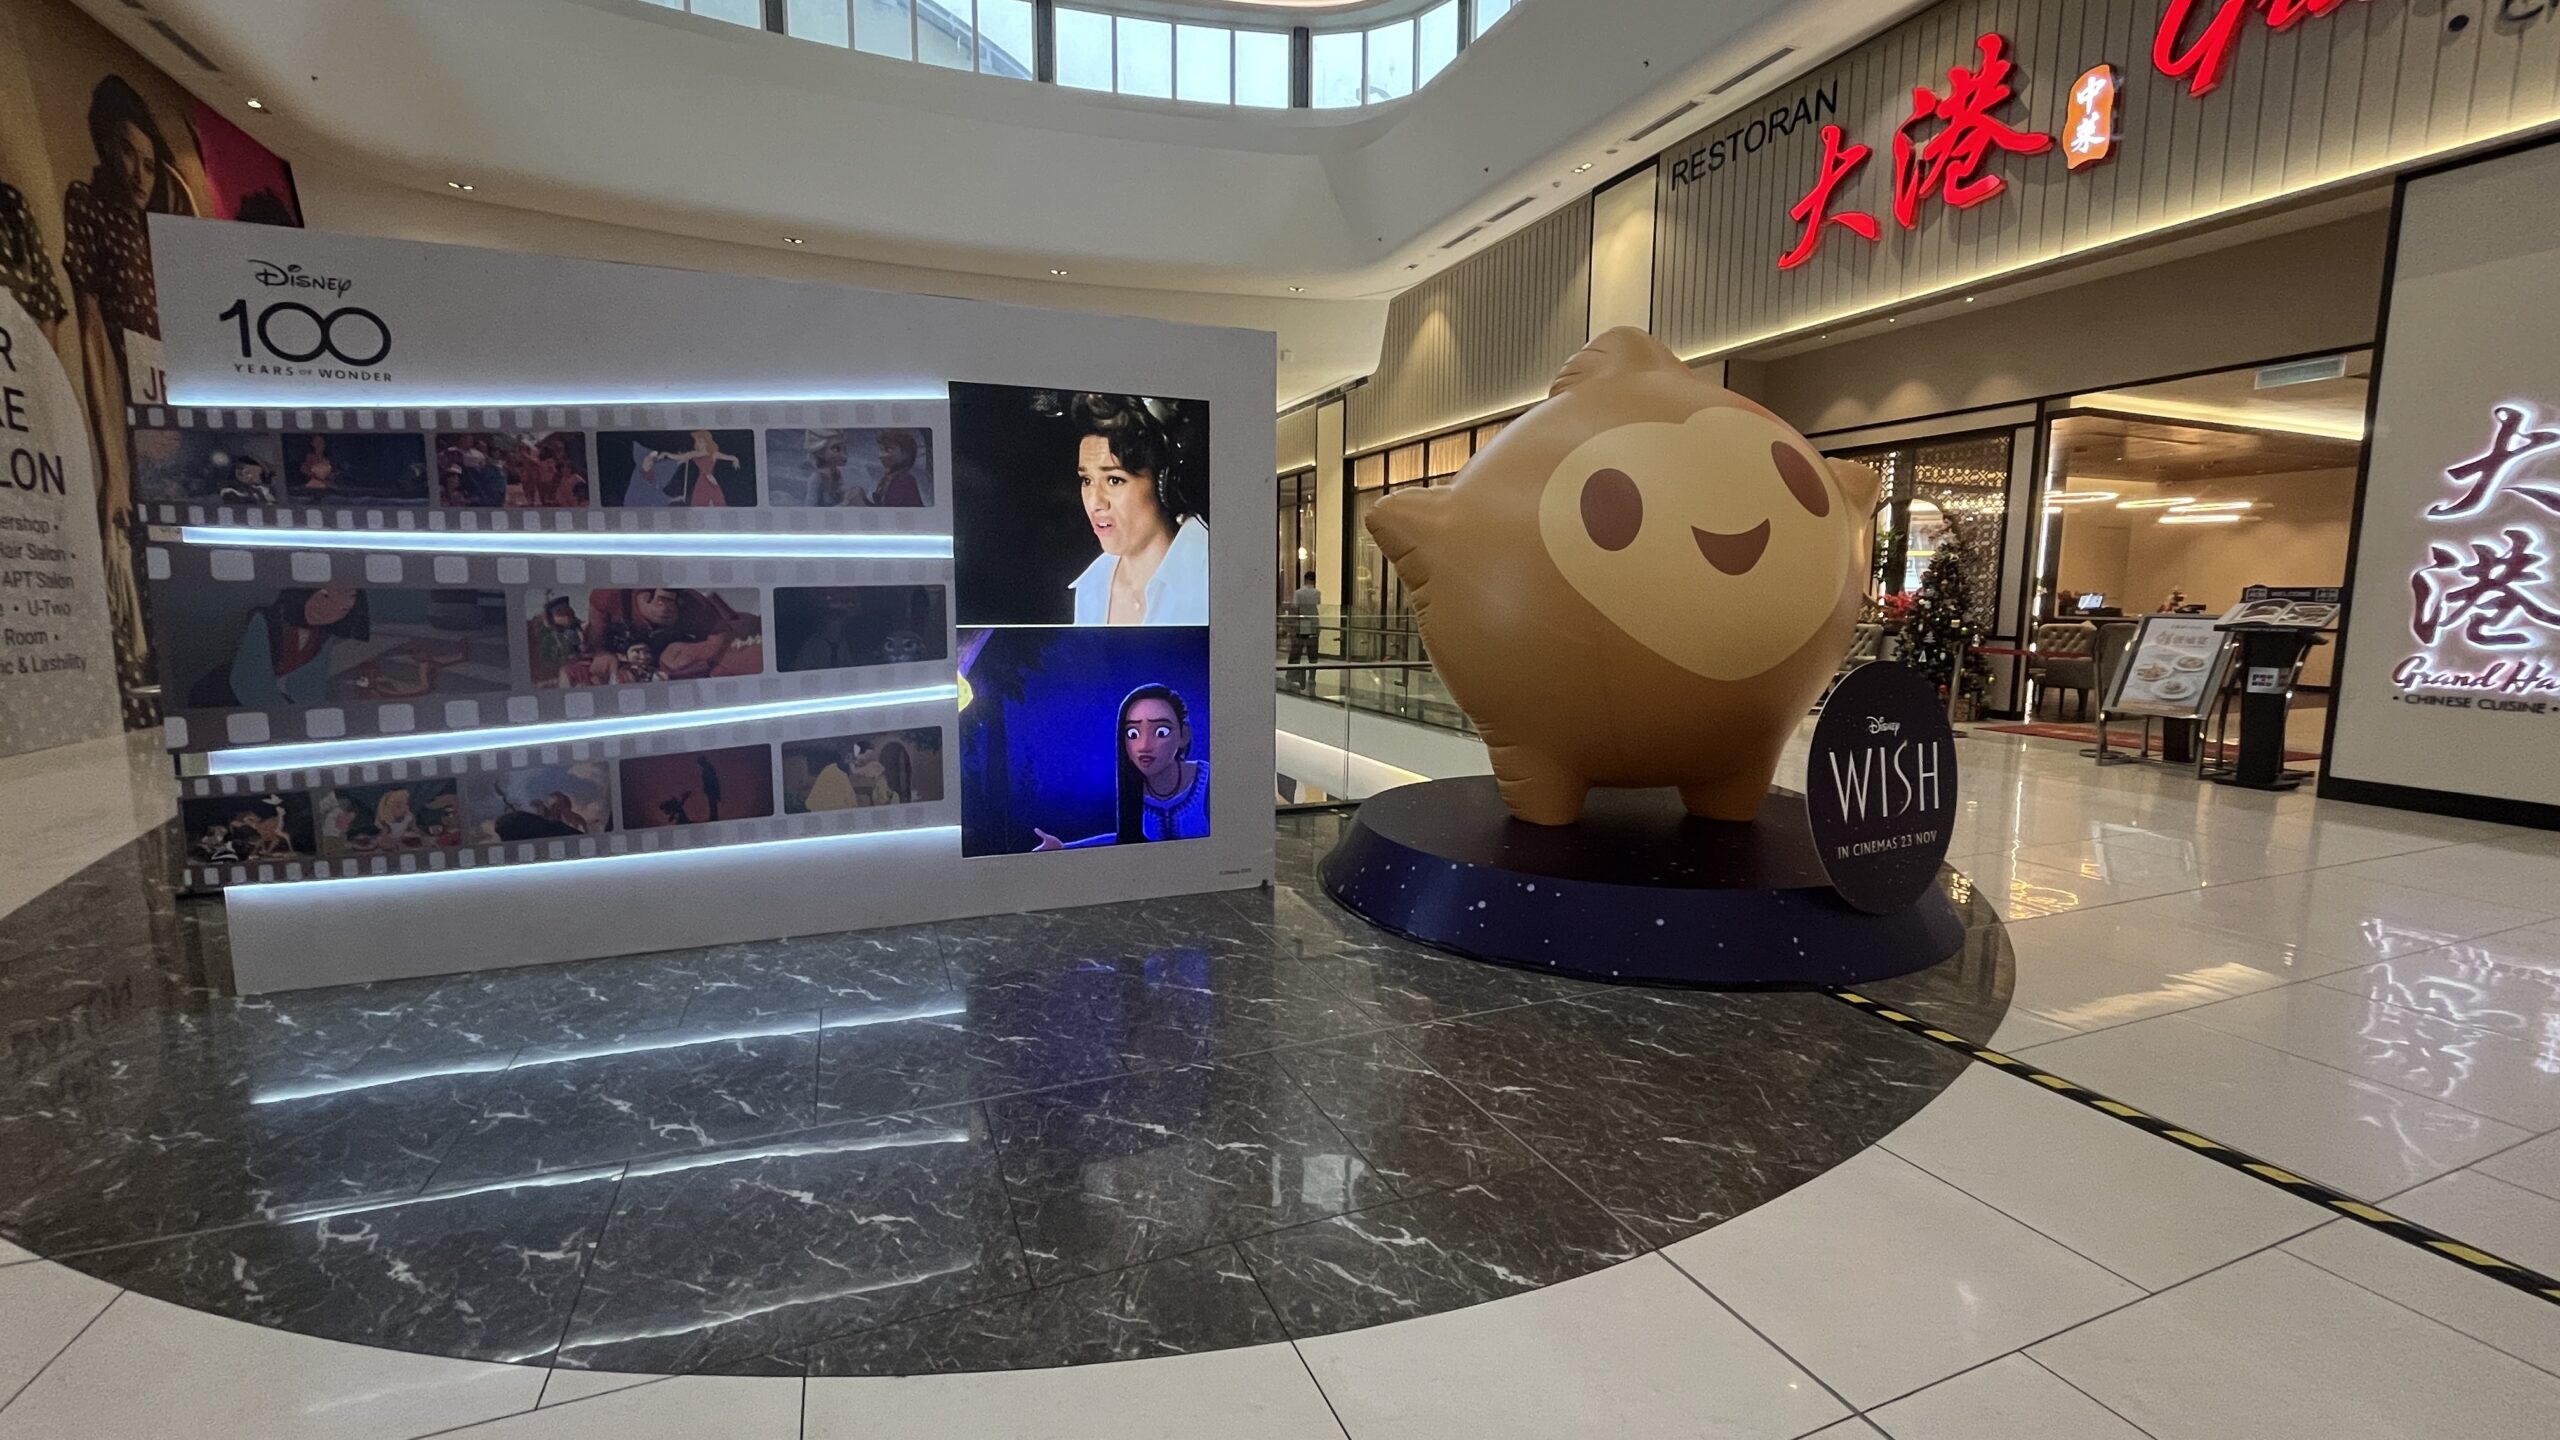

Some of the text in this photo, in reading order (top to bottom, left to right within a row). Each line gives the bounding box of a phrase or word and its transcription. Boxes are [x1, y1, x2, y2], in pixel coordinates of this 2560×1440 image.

[1671, 80, 1839, 191] RESTORAN
[1777, 32, 2054, 269] 大港
[248, 259, 352, 298] Disney
[219, 299, 391, 367] 100
[234, 363, 294, 376] YEARS
[319, 369, 392, 382] WONDER
[0, 386, 29, 432] E
[2412, 404, 2560, 647] 大港
[27, 543, 66, 561] Salon
[3, 571, 74, 589] APT Salon
[27, 599, 72, 617] U-Two
[4, 628, 48, 645] Room
[18, 657, 28, 674] &
[2391, 655, 2508, 690] Grand
[2405, 693, 2547, 714] CHINESE CUISINE
[1866, 715, 1901, 737] Disney
[1829, 739, 1940, 825] WISH
[1837, 829, 1938, 860] IN CINEMAS 23 NOV
